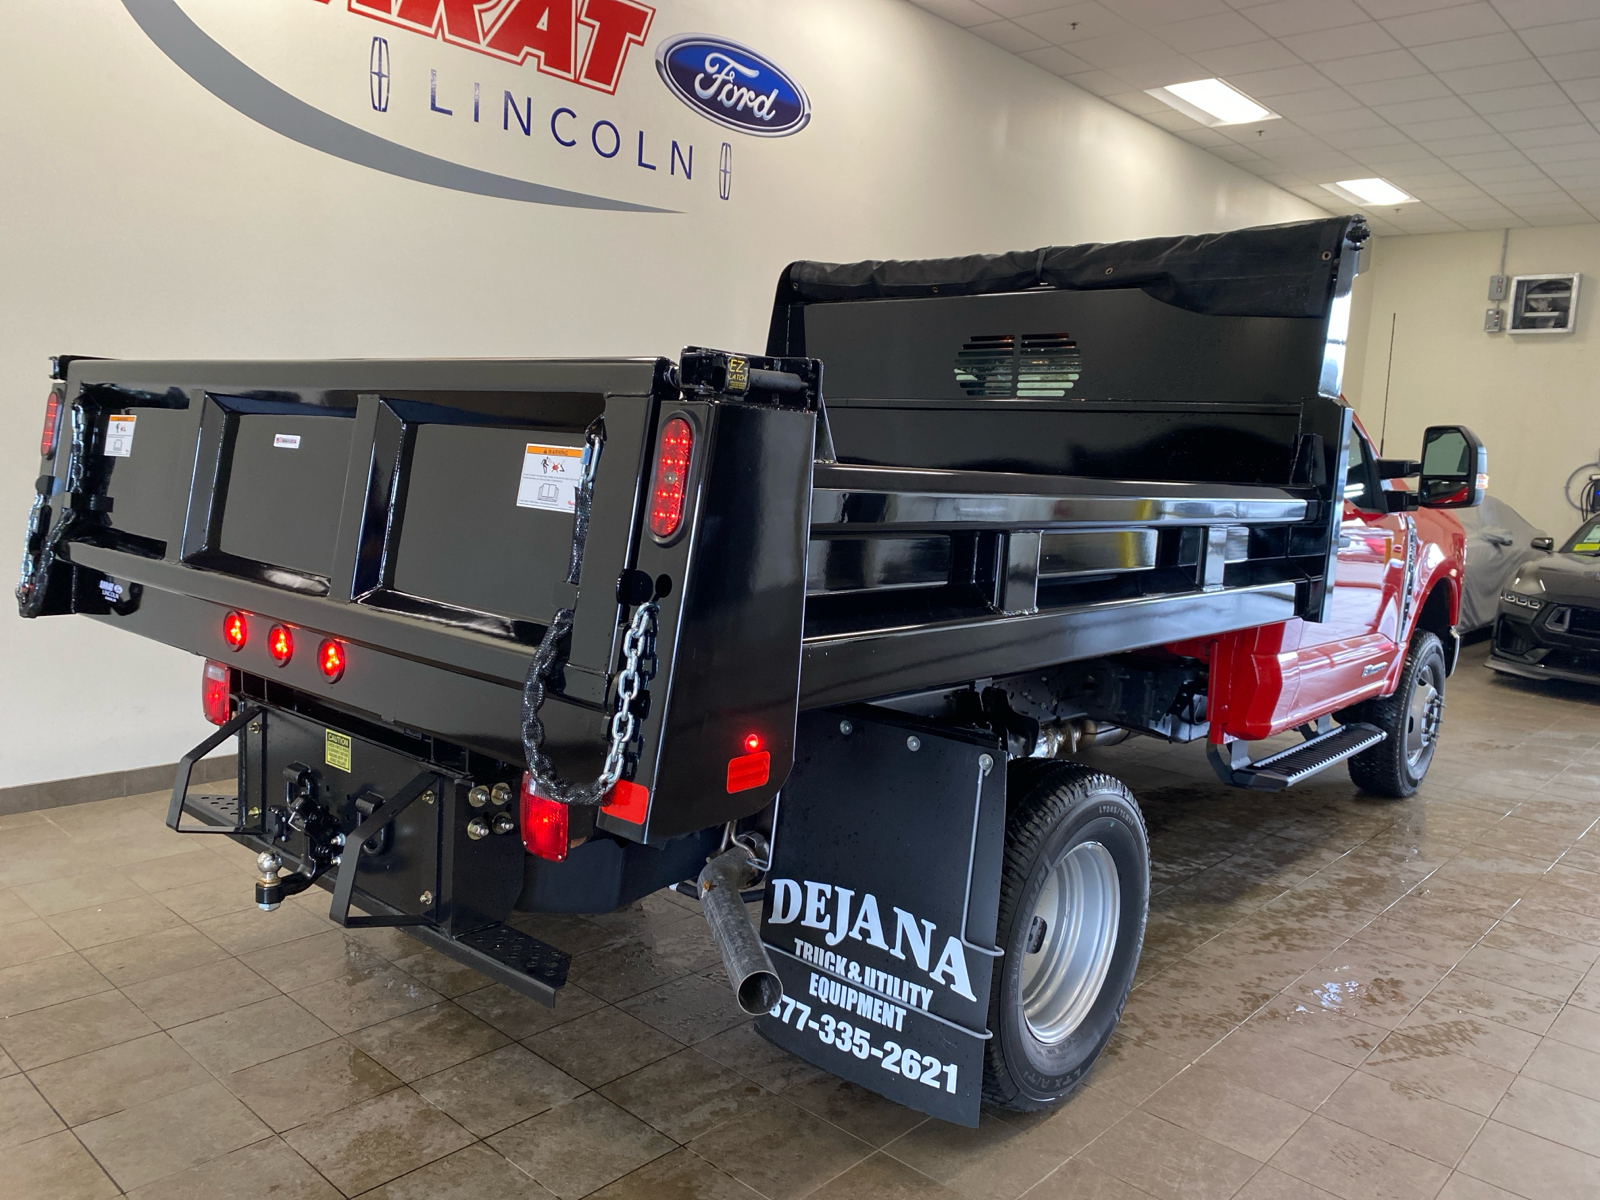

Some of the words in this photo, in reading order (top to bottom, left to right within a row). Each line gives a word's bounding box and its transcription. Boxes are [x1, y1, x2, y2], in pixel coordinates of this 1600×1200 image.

[430, 68, 693, 180] LINCOLN
[694, 52, 779, 123] Ford
[327, 733, 349, 747] CAUTION
[768, 878, 978, 1002] DEJANA
[794, 937, 848, 978] TRUCK
[864, 966, 934, 1012] UTILITY
[808, 972, 907, 1032] EQUIPMENT
